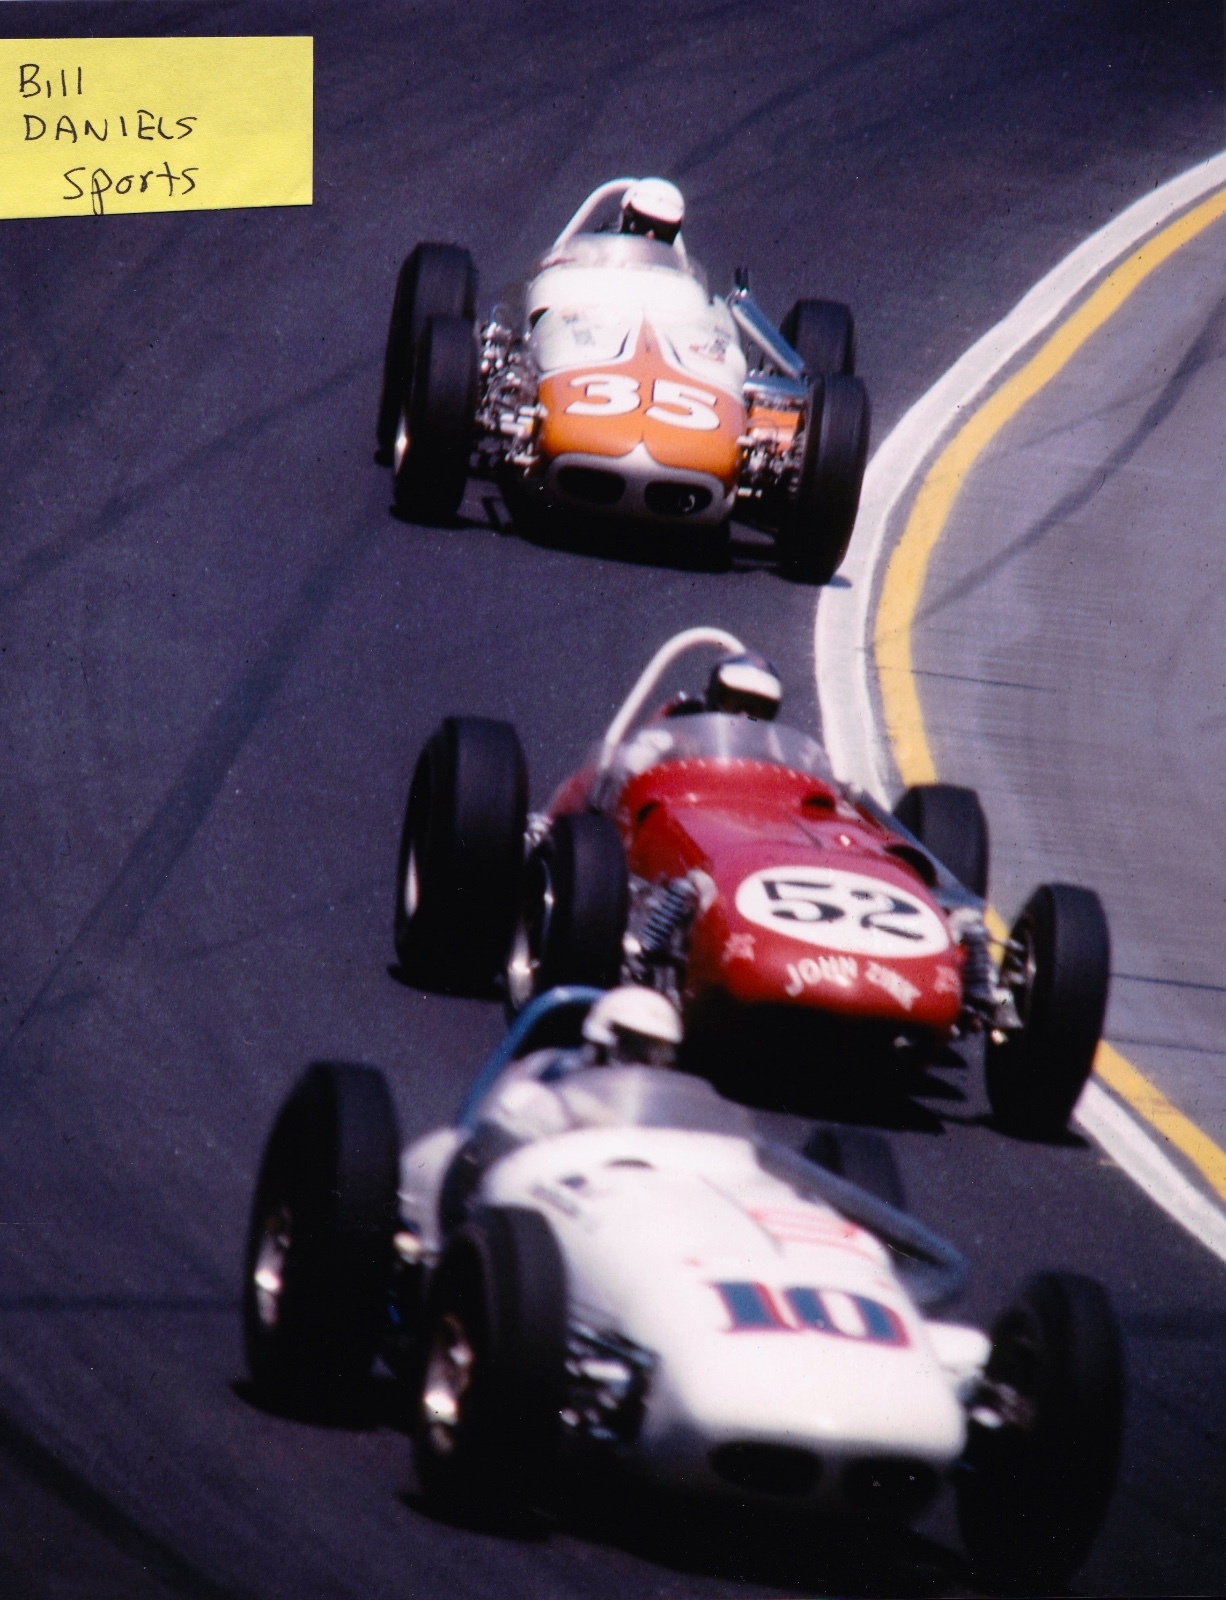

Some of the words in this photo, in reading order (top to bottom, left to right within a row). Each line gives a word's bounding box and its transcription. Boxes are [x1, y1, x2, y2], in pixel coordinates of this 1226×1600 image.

[19, 63, 83, 98] Bill
[23, 109, 198, 143] DANIELS
[564, 373, 721, 431] 35
[762, 880, 925, 941] 52
[706, 1279, 911, 1348] 10
